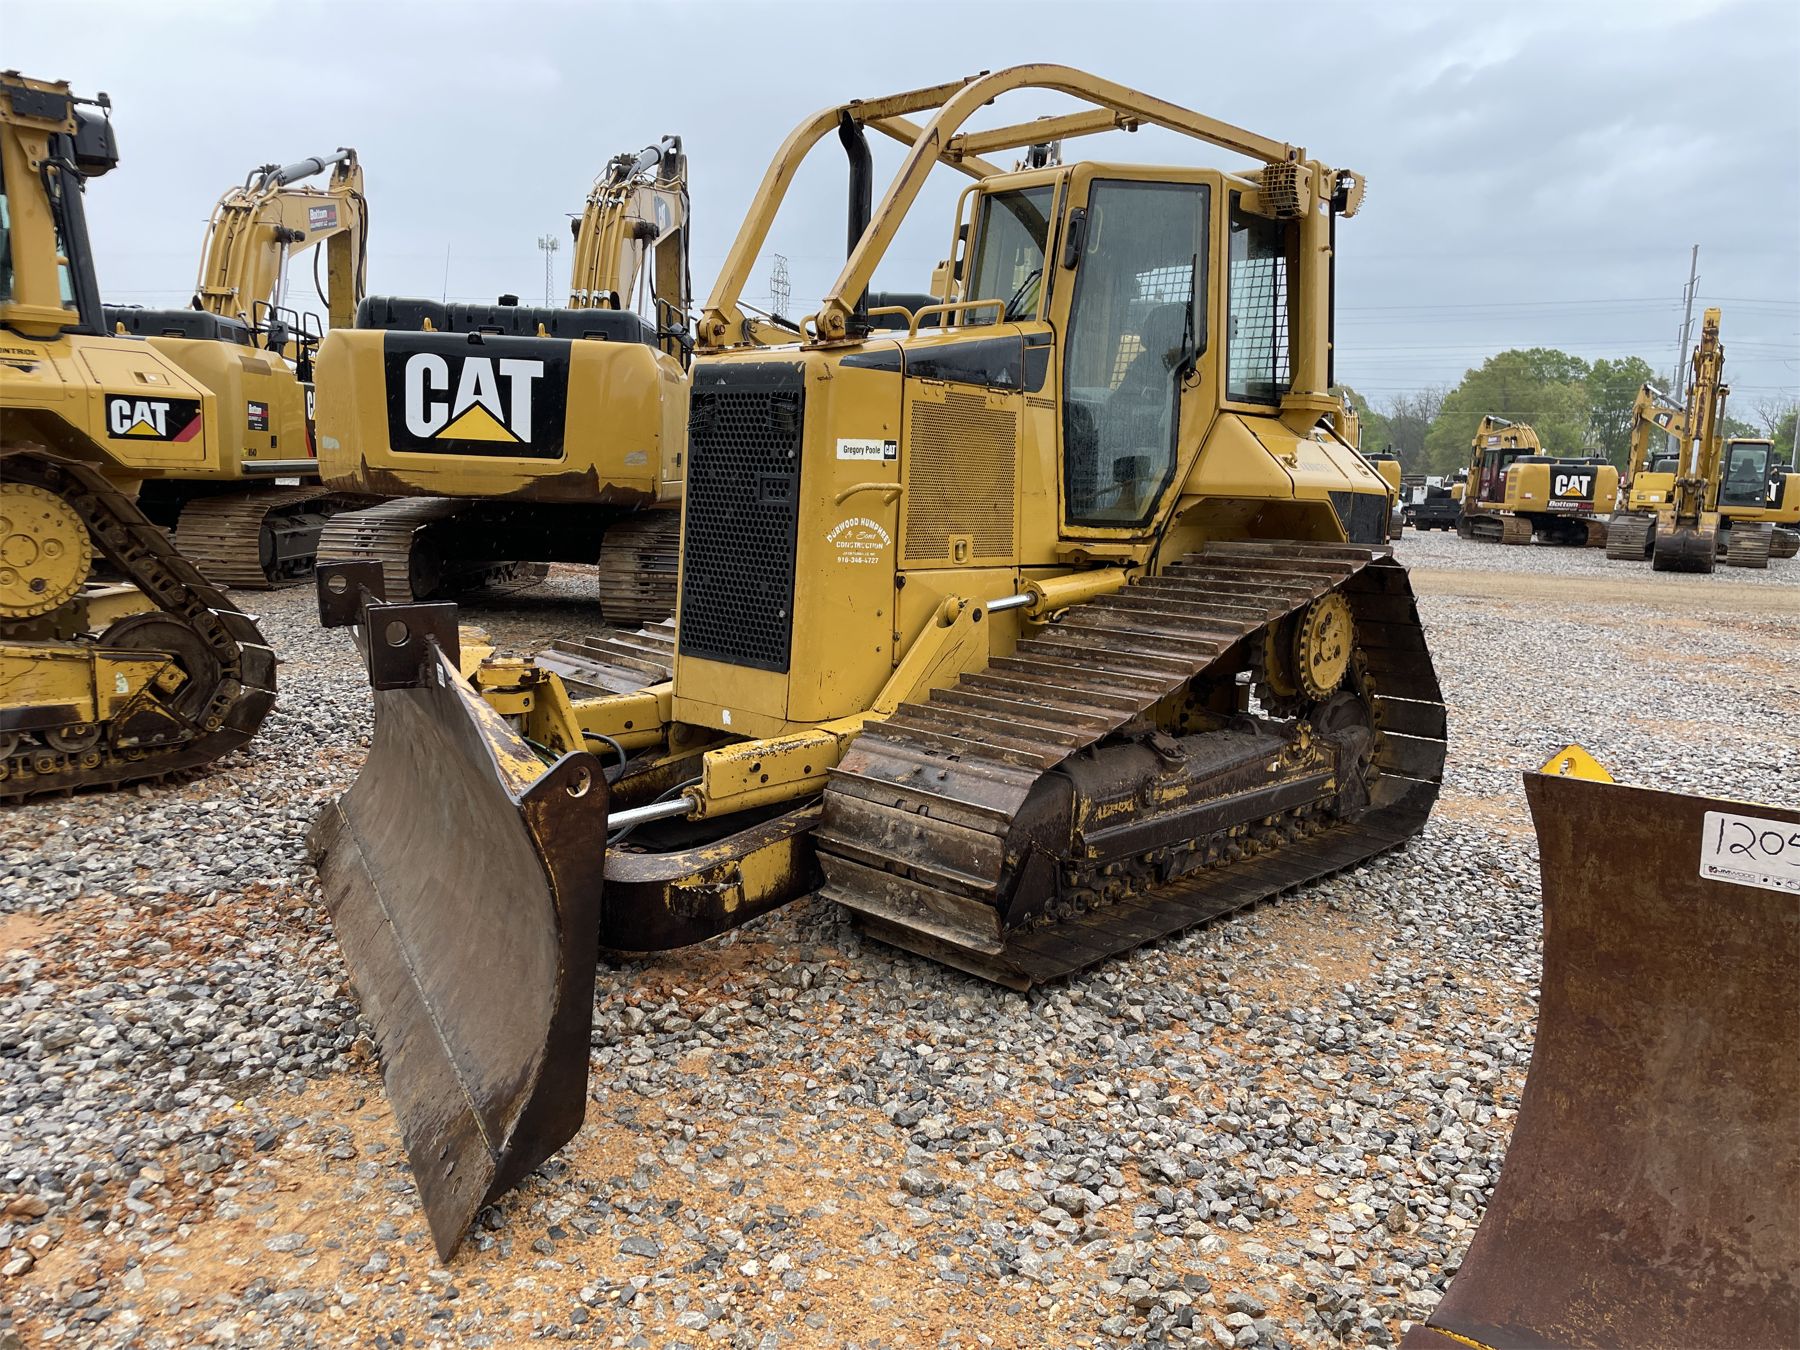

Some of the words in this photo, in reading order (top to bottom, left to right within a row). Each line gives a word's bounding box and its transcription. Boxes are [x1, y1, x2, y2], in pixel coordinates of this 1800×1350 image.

[405, 353, 544, 443] CAT
[111, 399, 170, 437] CAT
[843, 445, 864, 455] Gregory
[865, 446, 881, 454] Poole
[884, 444, 897, 455] CAT
[1555, 474, 1591, 497] CAT
[1549, 500, 1578, 508] Bottom
[826, 517, 859, 543] DURWOOD
[860, 517, 892, 546] HUMPHREY
